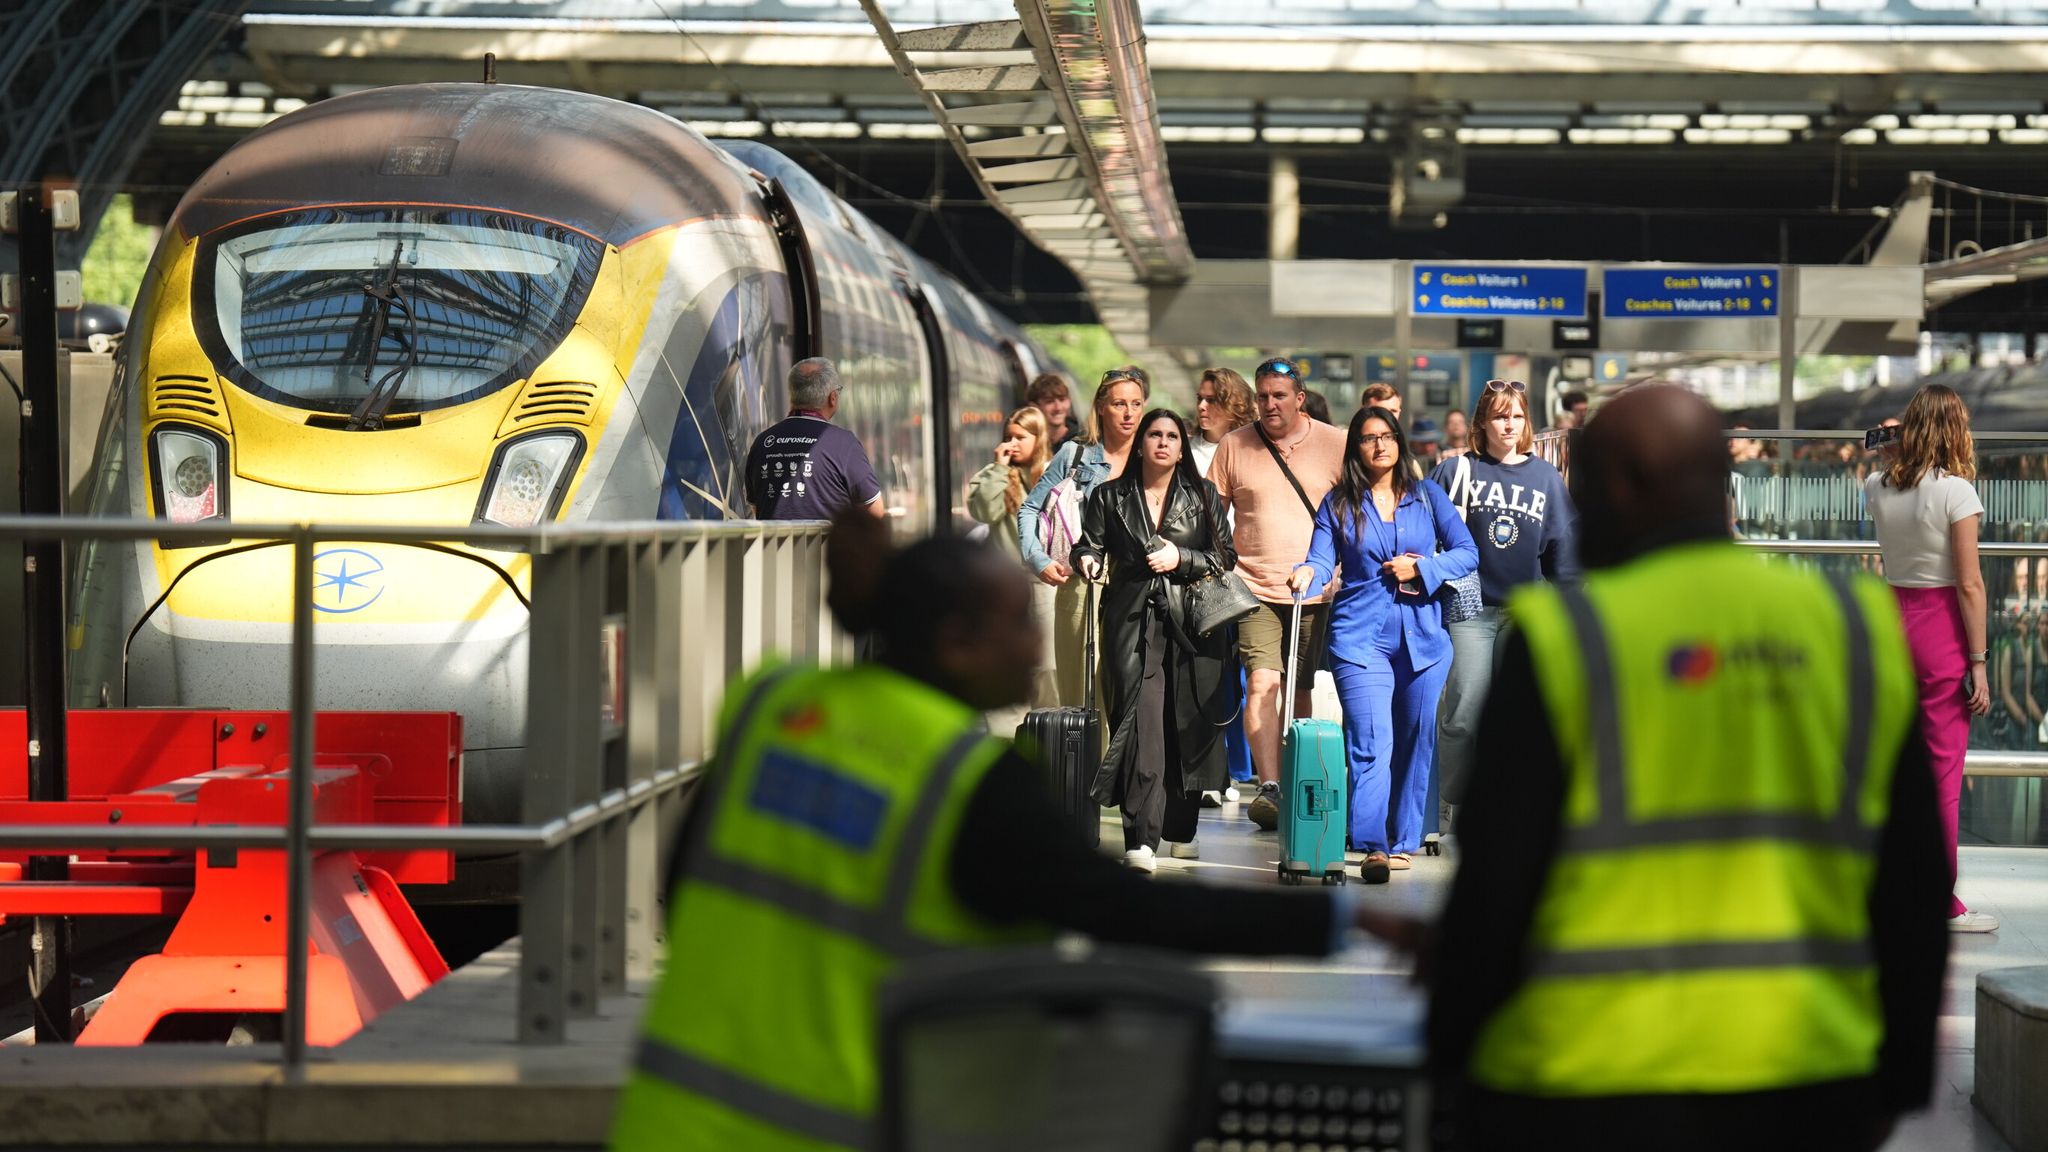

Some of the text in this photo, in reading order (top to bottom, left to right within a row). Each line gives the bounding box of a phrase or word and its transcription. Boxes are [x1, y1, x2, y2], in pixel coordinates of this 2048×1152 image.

[1441, 273, 1527, 287] Coach Voiture 1
[1664, 276, 1751, 289] Coach Voiture 1
[1440, 294, 1488, 308] Coaches
[1489, 296, 1537, 310] Voitures
[1625, 298, 1673, 311] Coaches
[1674, 298, 1722, 311] Voitures
[1604, 359, 1618, 379] 6
[1469, 480, 1545, 522] YALE
